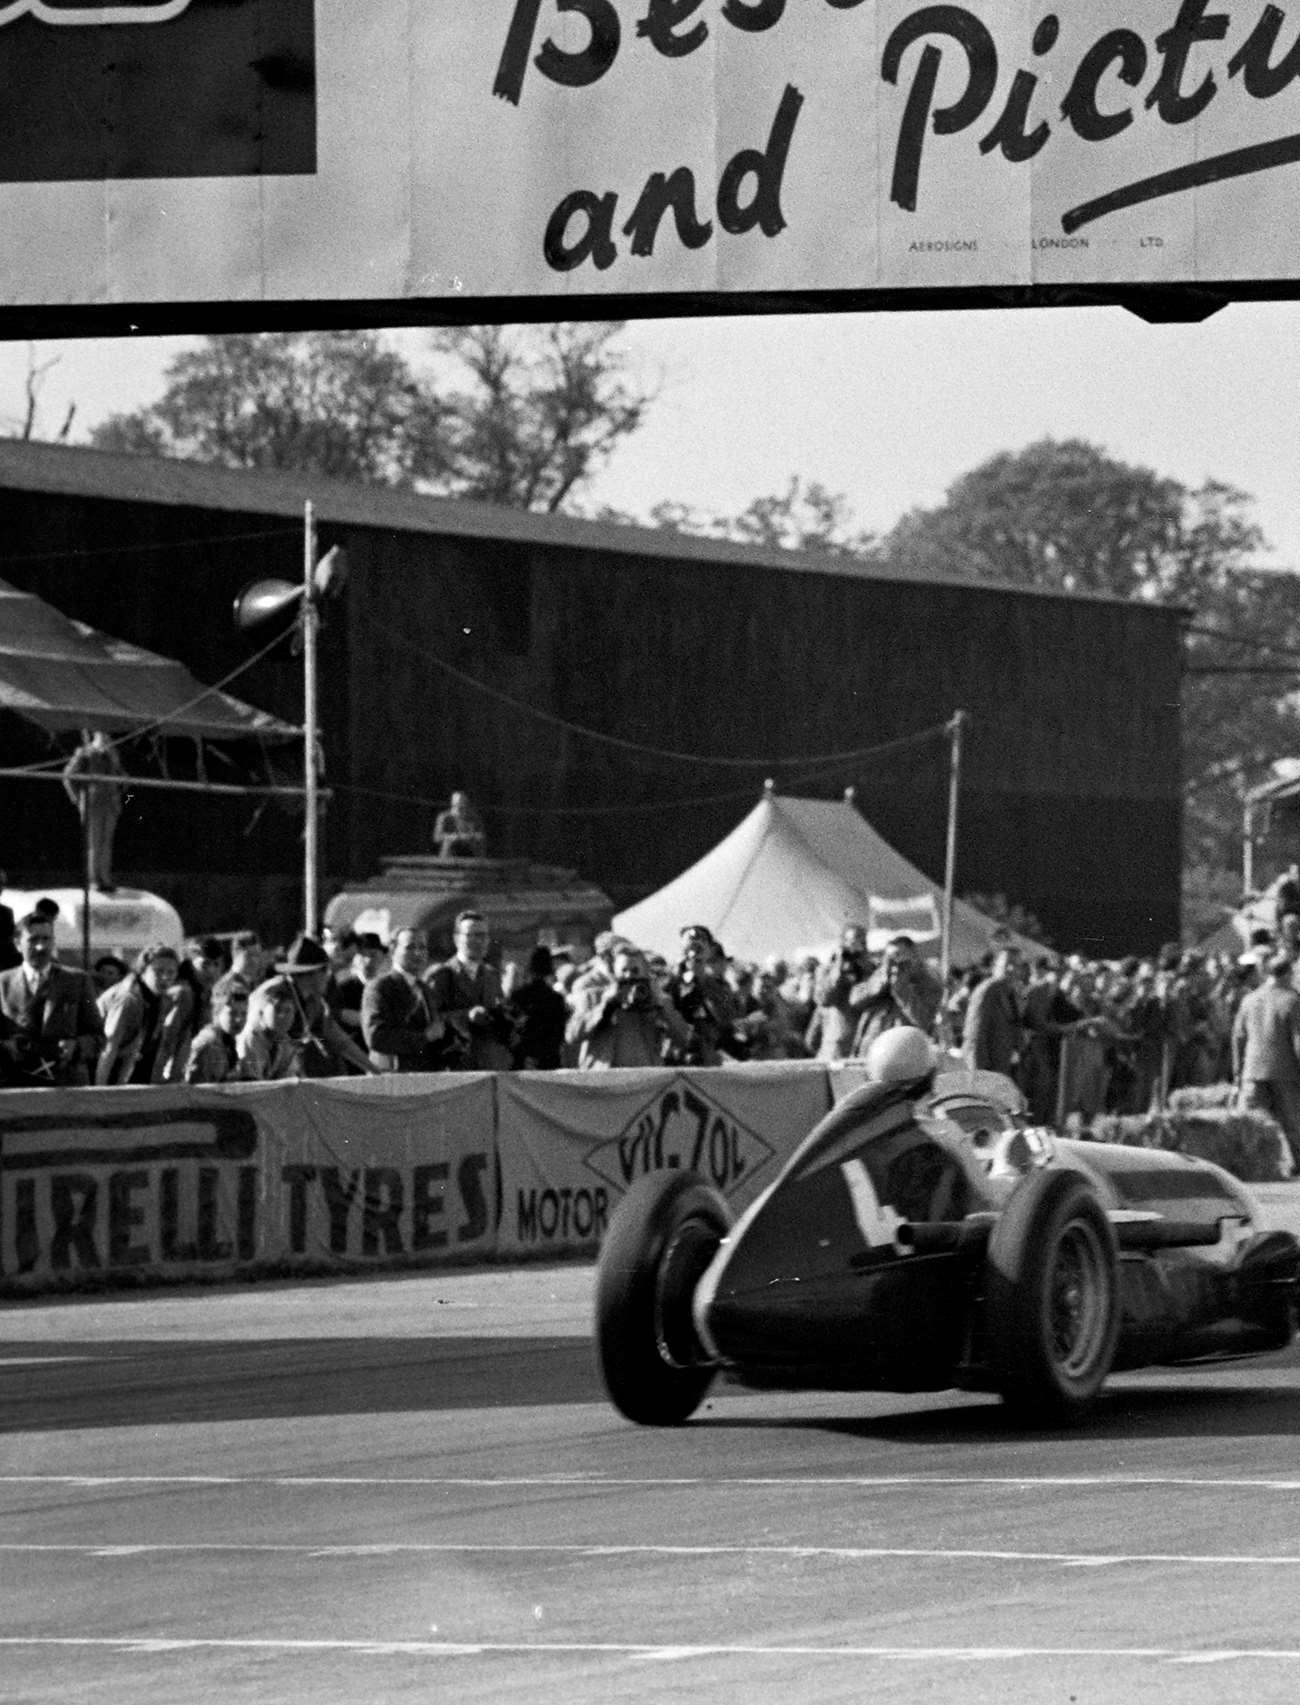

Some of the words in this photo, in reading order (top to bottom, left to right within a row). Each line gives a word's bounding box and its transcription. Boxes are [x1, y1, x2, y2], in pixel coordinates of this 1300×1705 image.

[544, 83, 804, 272] and
[908, 240, 978, 252] AEROSIGNS
[1031, 237, 1090, 249] LONDON
[1139, 236, 1164, 248] LTD
[282, 1152, 488, 1256] TYRES
[517, 1186, 608, 1241] MOTOR
